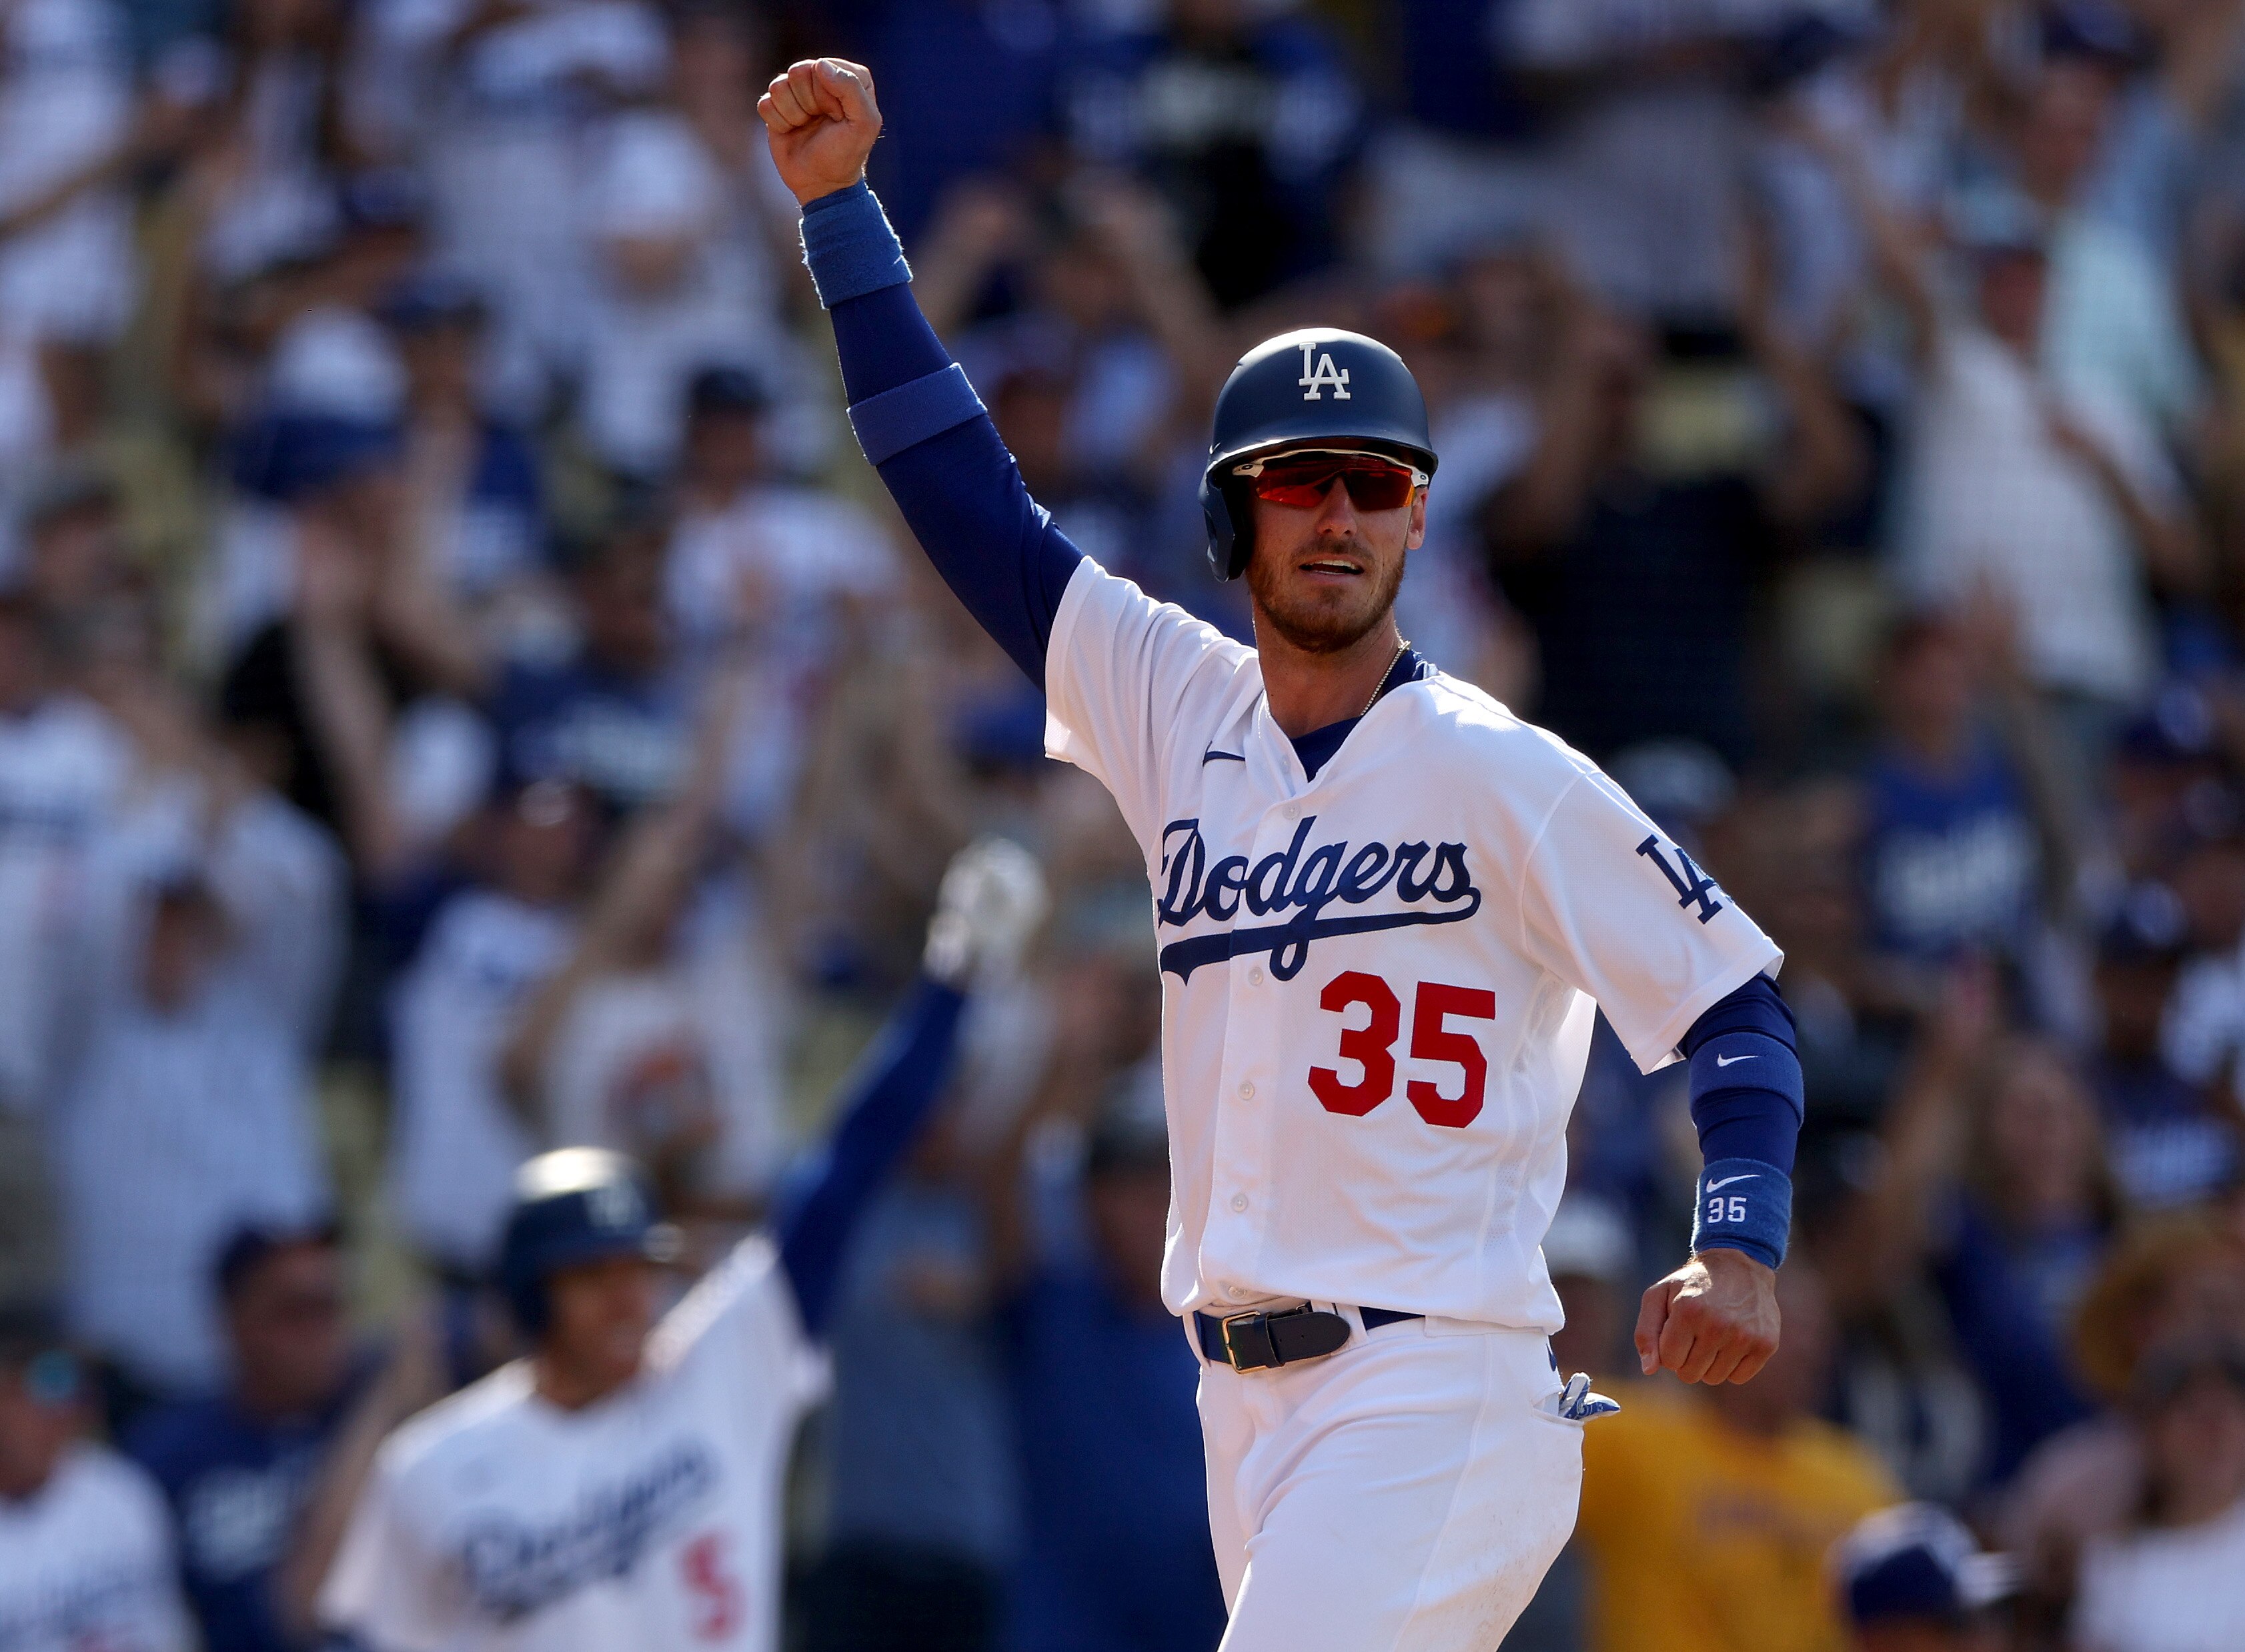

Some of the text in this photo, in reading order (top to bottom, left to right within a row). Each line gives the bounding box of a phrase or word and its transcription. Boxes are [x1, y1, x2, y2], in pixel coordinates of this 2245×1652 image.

[1299, 342, 1351, 401] LA
[1159, 815, 1481, 986] Dodgers
[1307, 970, 1496, 1128] 35
[1707, 1196, 1747, 1224] 35
[678, 1526, 747, 1643] 5
